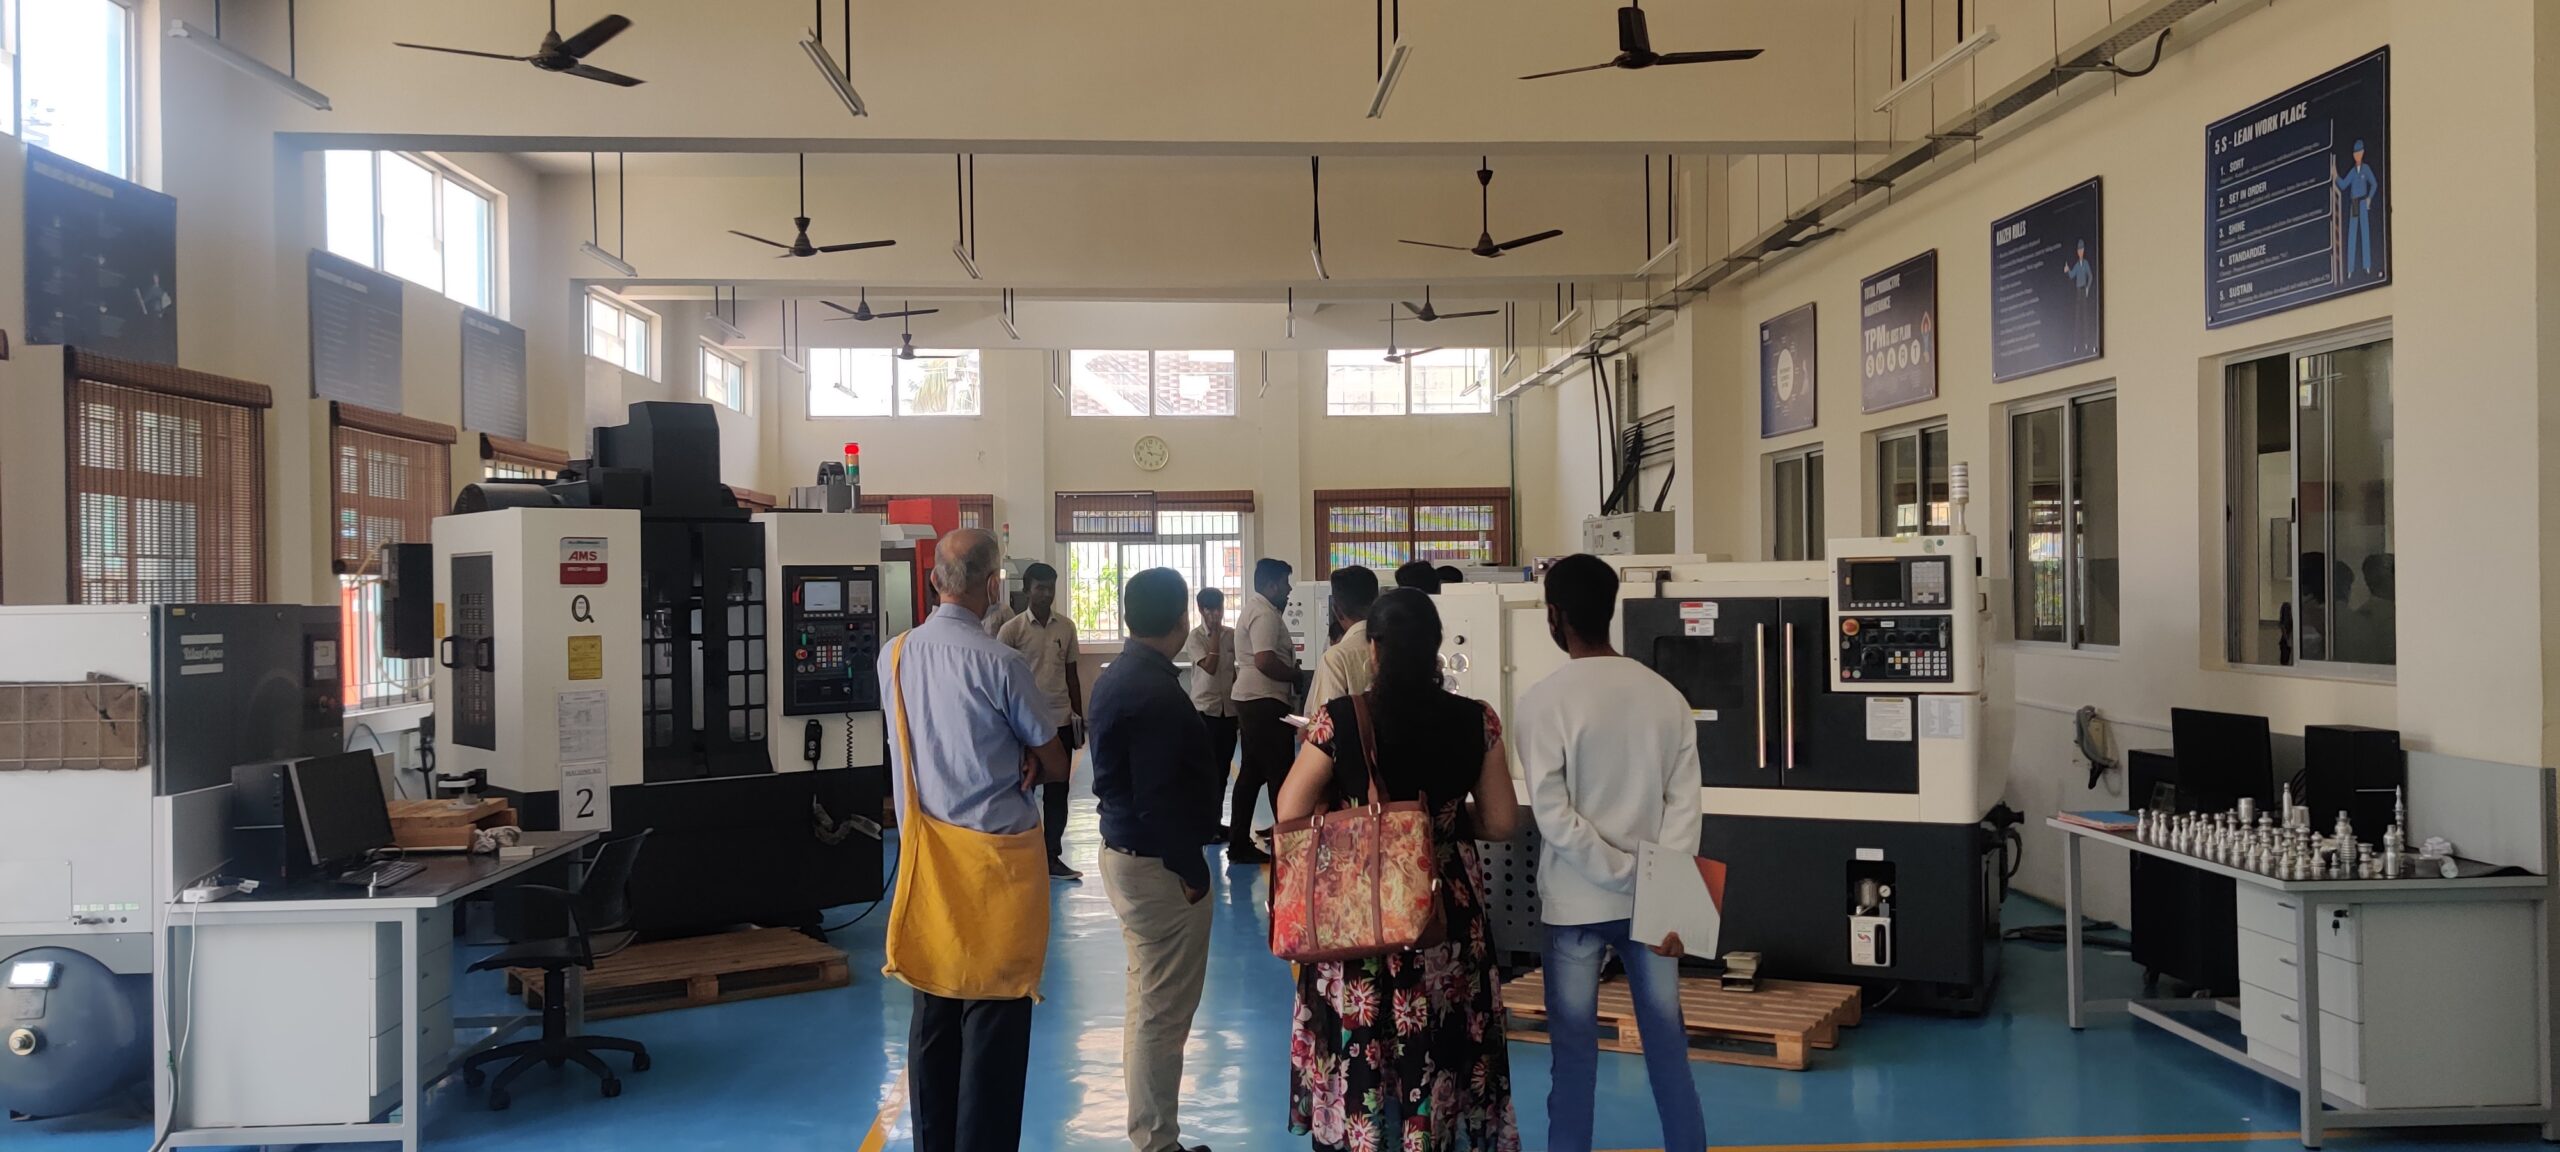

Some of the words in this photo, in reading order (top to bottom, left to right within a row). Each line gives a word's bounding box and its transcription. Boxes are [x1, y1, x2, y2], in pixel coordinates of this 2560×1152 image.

[2214, 139, 2221, 155] 5
[2221, 136, 2228, 153] S
[2233, 124, 2254, 148] LEAN
[2254, 113, 2279, 138] WORK
[2279, 101, 2308, 128] PLACE
[2229, 157, 2245, 173] SORT
[2228, 191, 2240, 205] SET
[2240, 188, 2247, 201] IN
[2247, 181, 2268, 198] ORDER
[2228, 220, 2246, 236] SHINE
[2228, 244, 2267, 266] STANDARDIZE
[2229, 282, 2253, 299] SUSTAIN
[1864, 323, 1886, 353] TPM
[568, 551, 598, 561] AMS
[576, 788, 595, 819] 2
